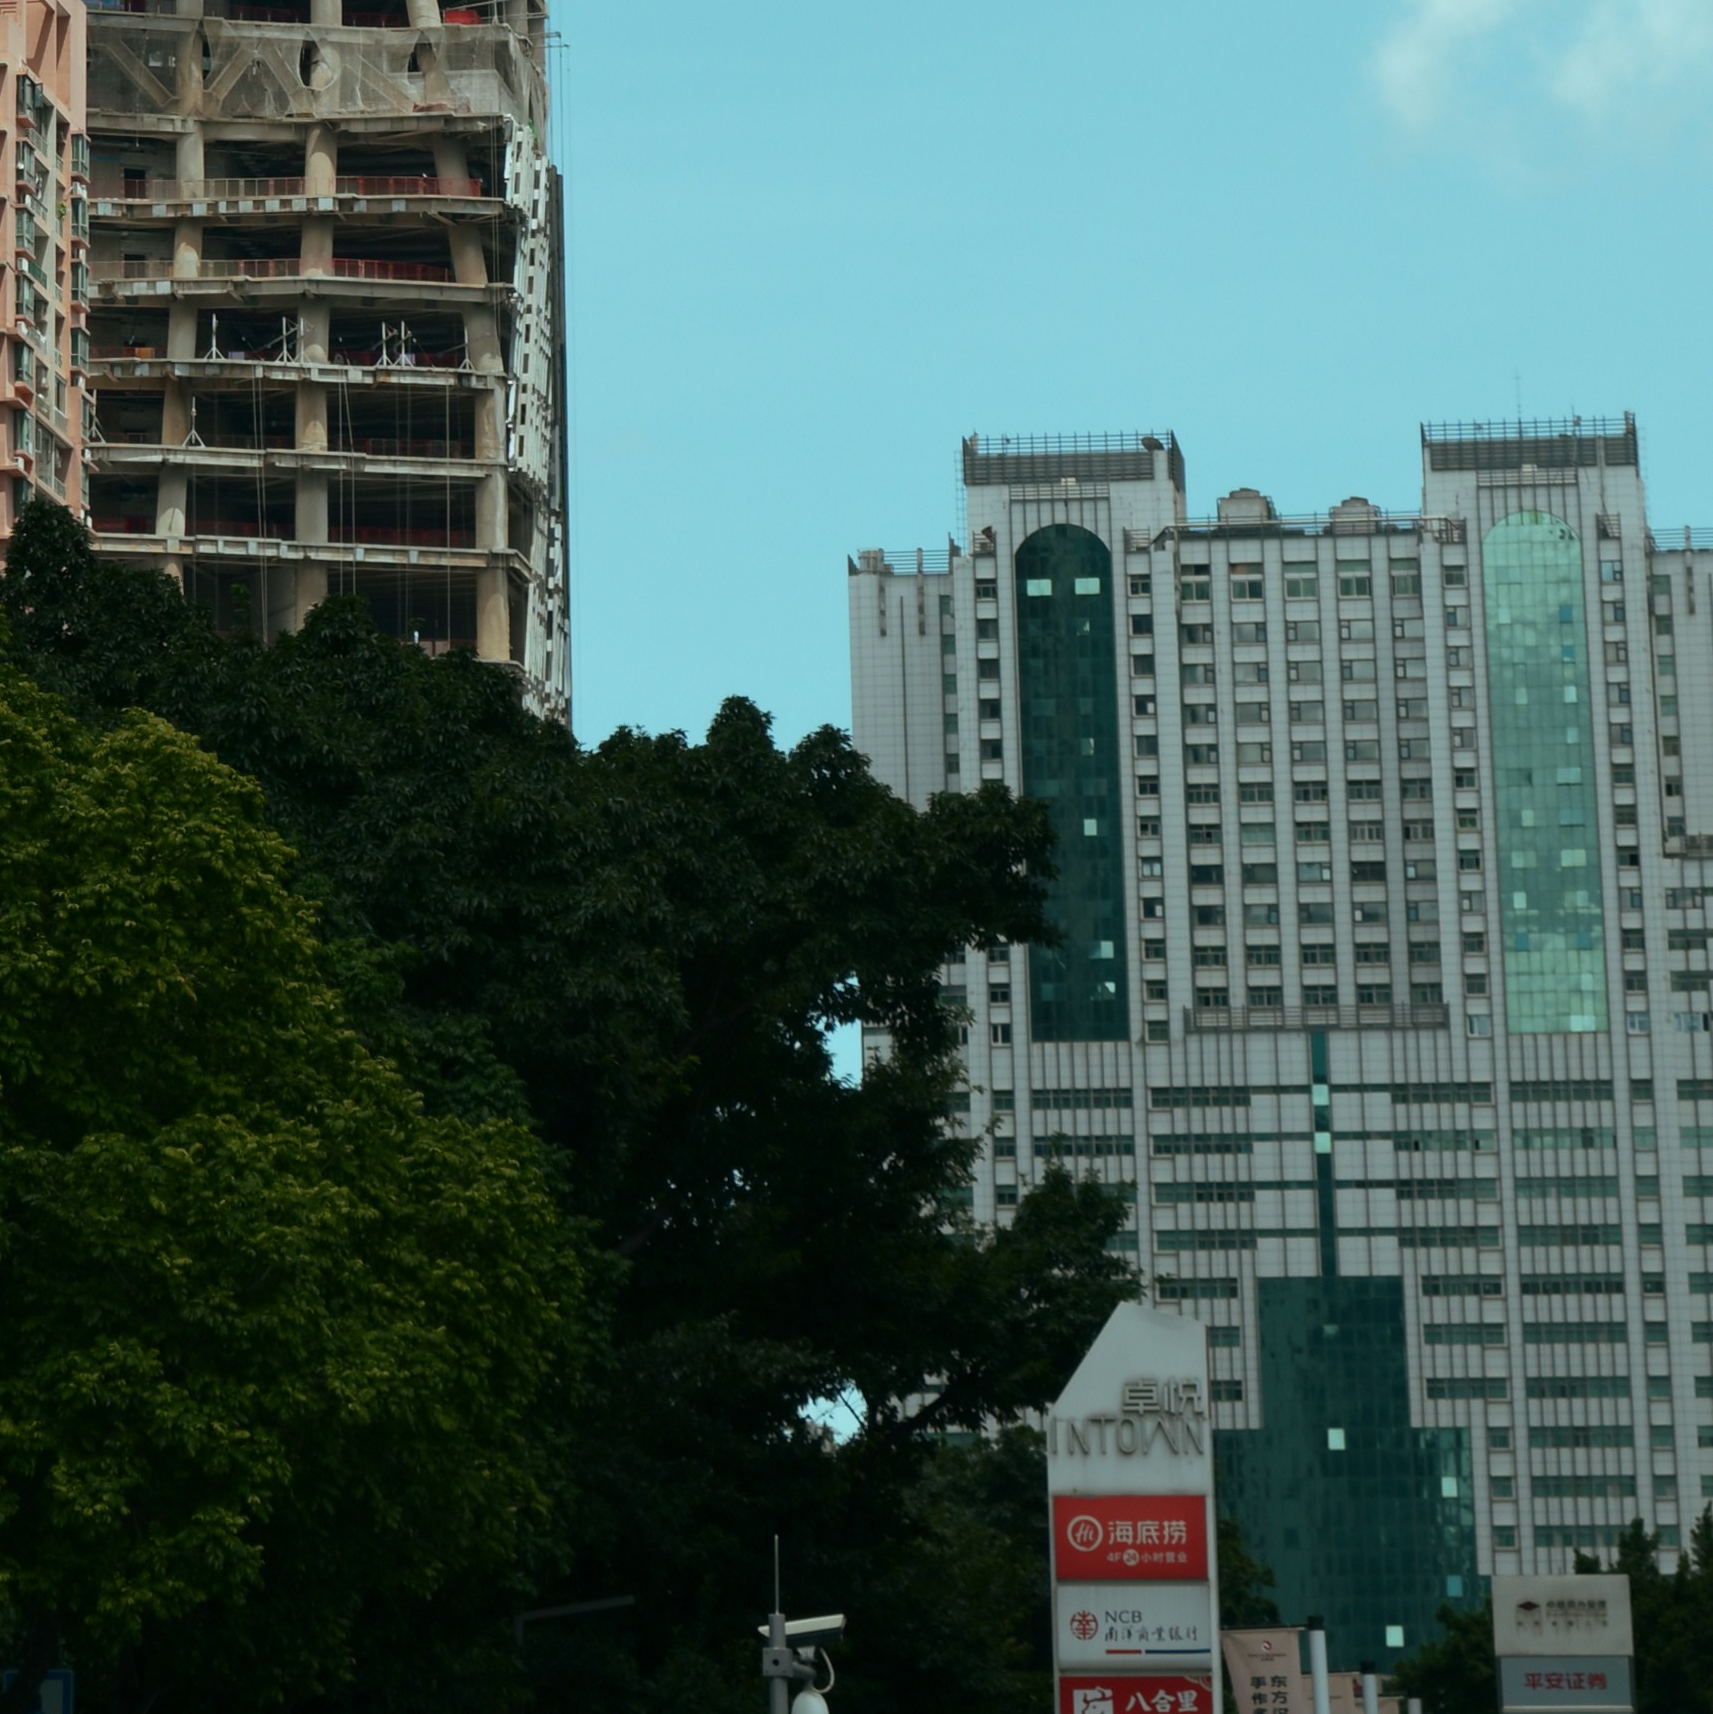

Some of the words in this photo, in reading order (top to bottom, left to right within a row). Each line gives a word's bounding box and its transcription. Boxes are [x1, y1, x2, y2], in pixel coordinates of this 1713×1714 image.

[1123, 1378, 1204, 1415] 卓悦
[1050, 1416, 1204, 1456] INTOWN
[1108, 1520, 1186, 1545] 海底捞
[1105, 1610, 1142, 1623] NCB
[1525, 1671, 1607, 1690] 平安证券
[1126, 1689, 1198, 1712] 八合里
